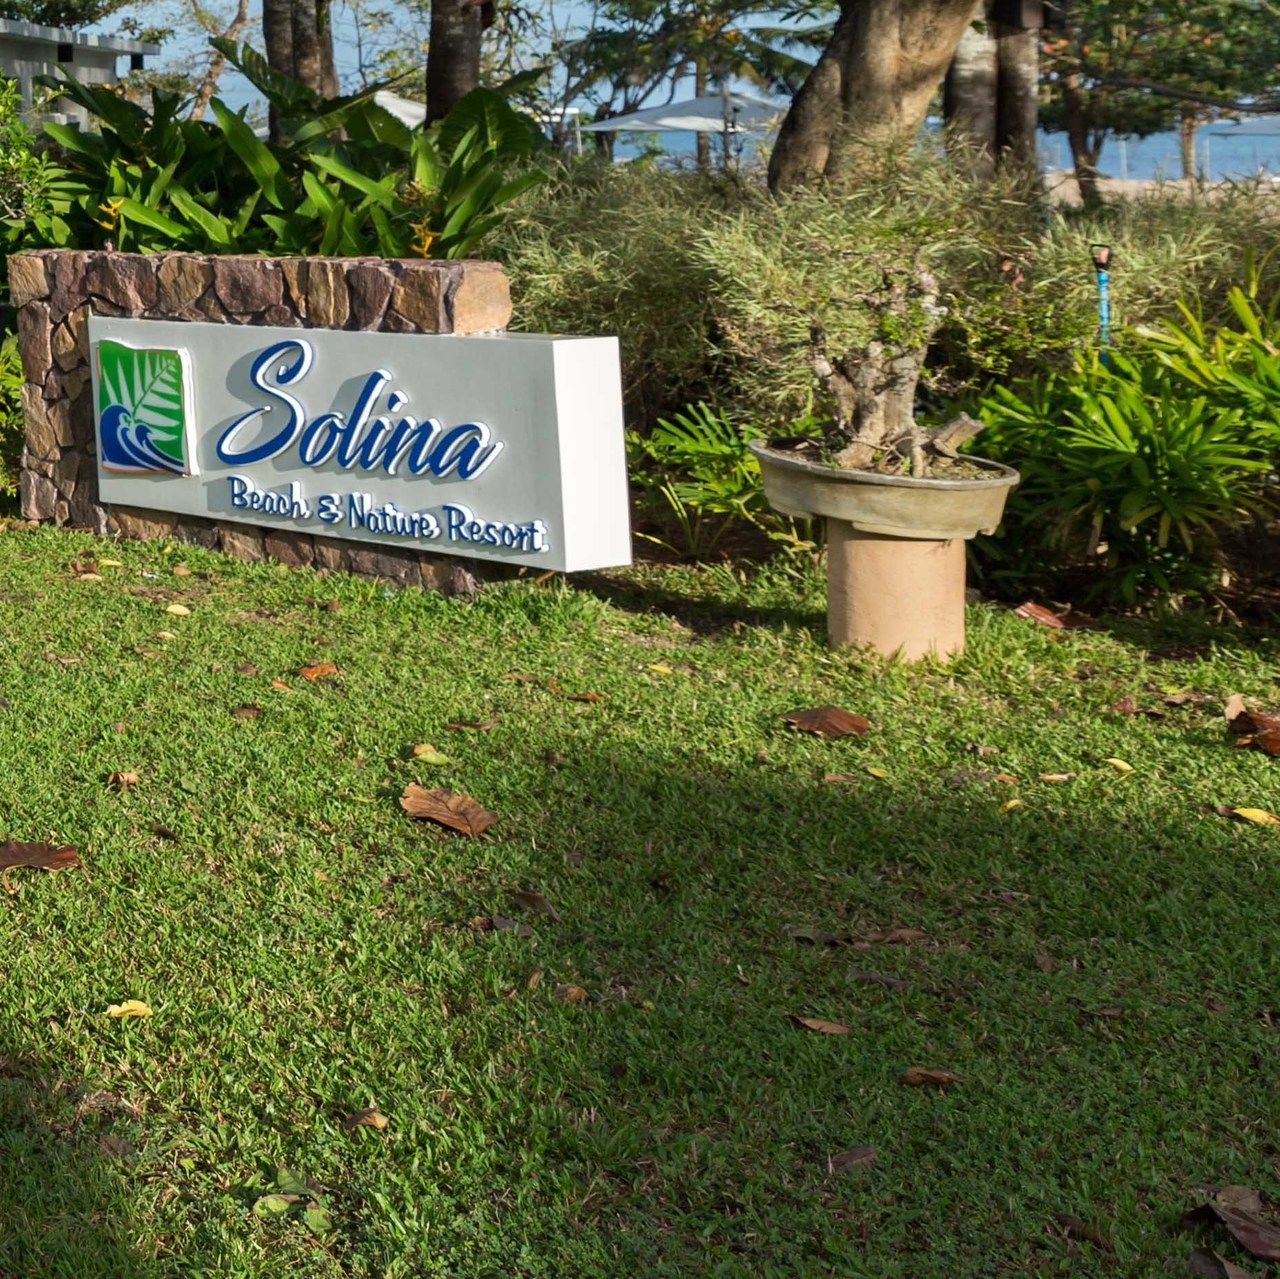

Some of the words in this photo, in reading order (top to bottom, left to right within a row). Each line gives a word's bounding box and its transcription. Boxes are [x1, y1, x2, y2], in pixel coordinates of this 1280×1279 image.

[217, 338, 504, 480] Solina
[227, 475, 311, 519] Beach
[317, 493, 344, 523] &
[348, 492, 440, 538] Nature
[442, 503, 549, 552] Resort
